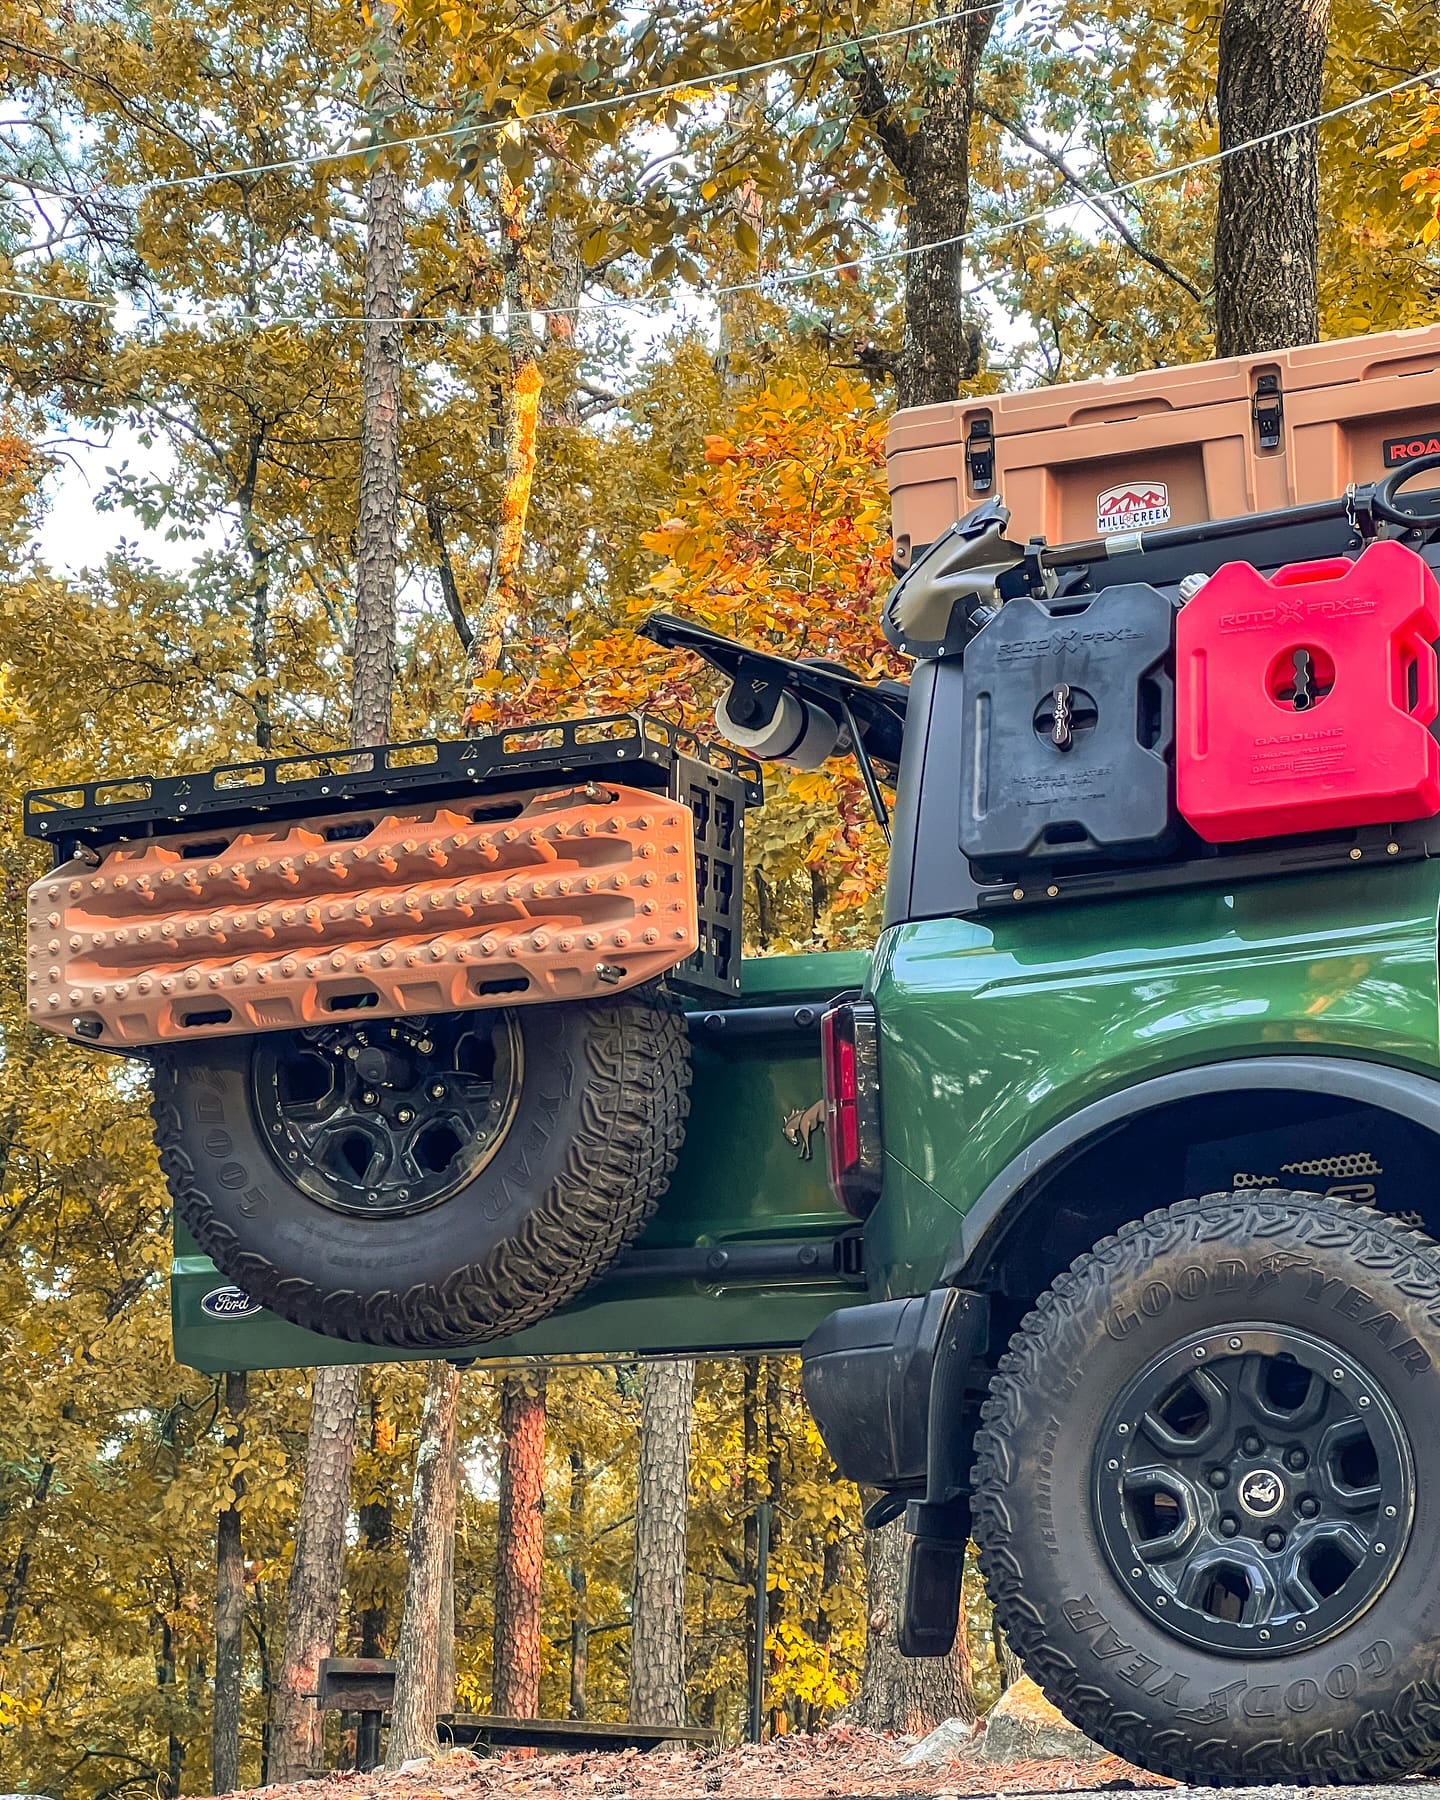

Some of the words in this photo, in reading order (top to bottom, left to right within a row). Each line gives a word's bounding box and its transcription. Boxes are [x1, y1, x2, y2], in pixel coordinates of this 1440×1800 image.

[1098, 515, 1125, 529] MILL
[1133, 507, 1169, 523] CREEK
[1254, 727, 1345, 746] GASOLINE
[214, 1292, 250, 1312] Ford
